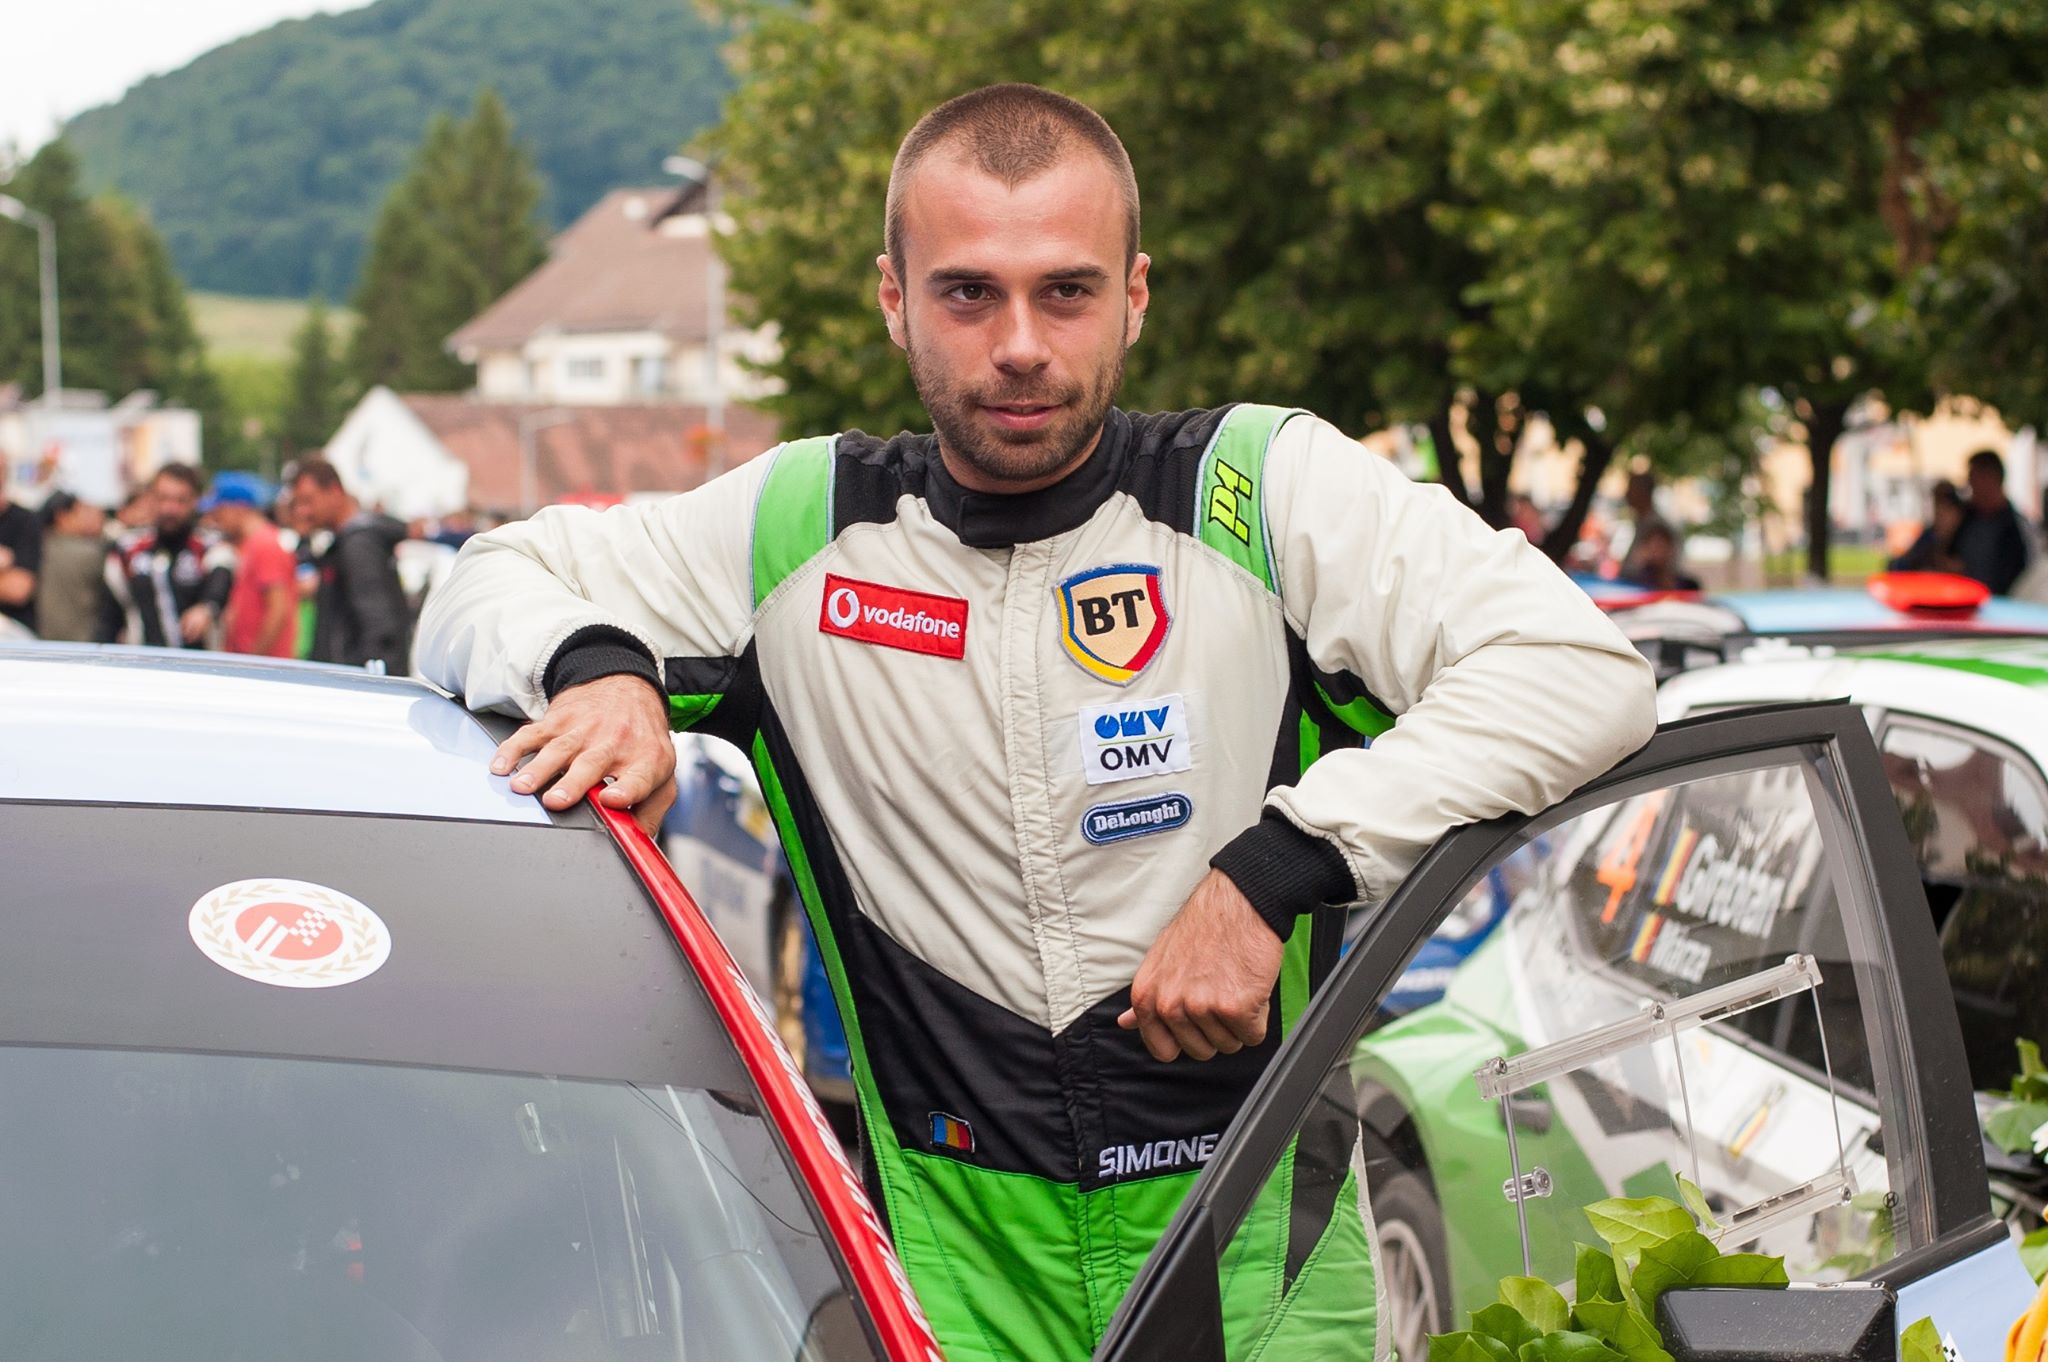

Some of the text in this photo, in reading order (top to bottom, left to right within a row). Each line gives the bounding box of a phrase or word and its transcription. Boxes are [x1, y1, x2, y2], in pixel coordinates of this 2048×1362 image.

[863, 607, 960, 639] vodafone
[1077, 589, 1145, 636] BT
[1100, 739, 1173, 770] OMV
[1098, 1133, 1219, 1178] SIMONE
